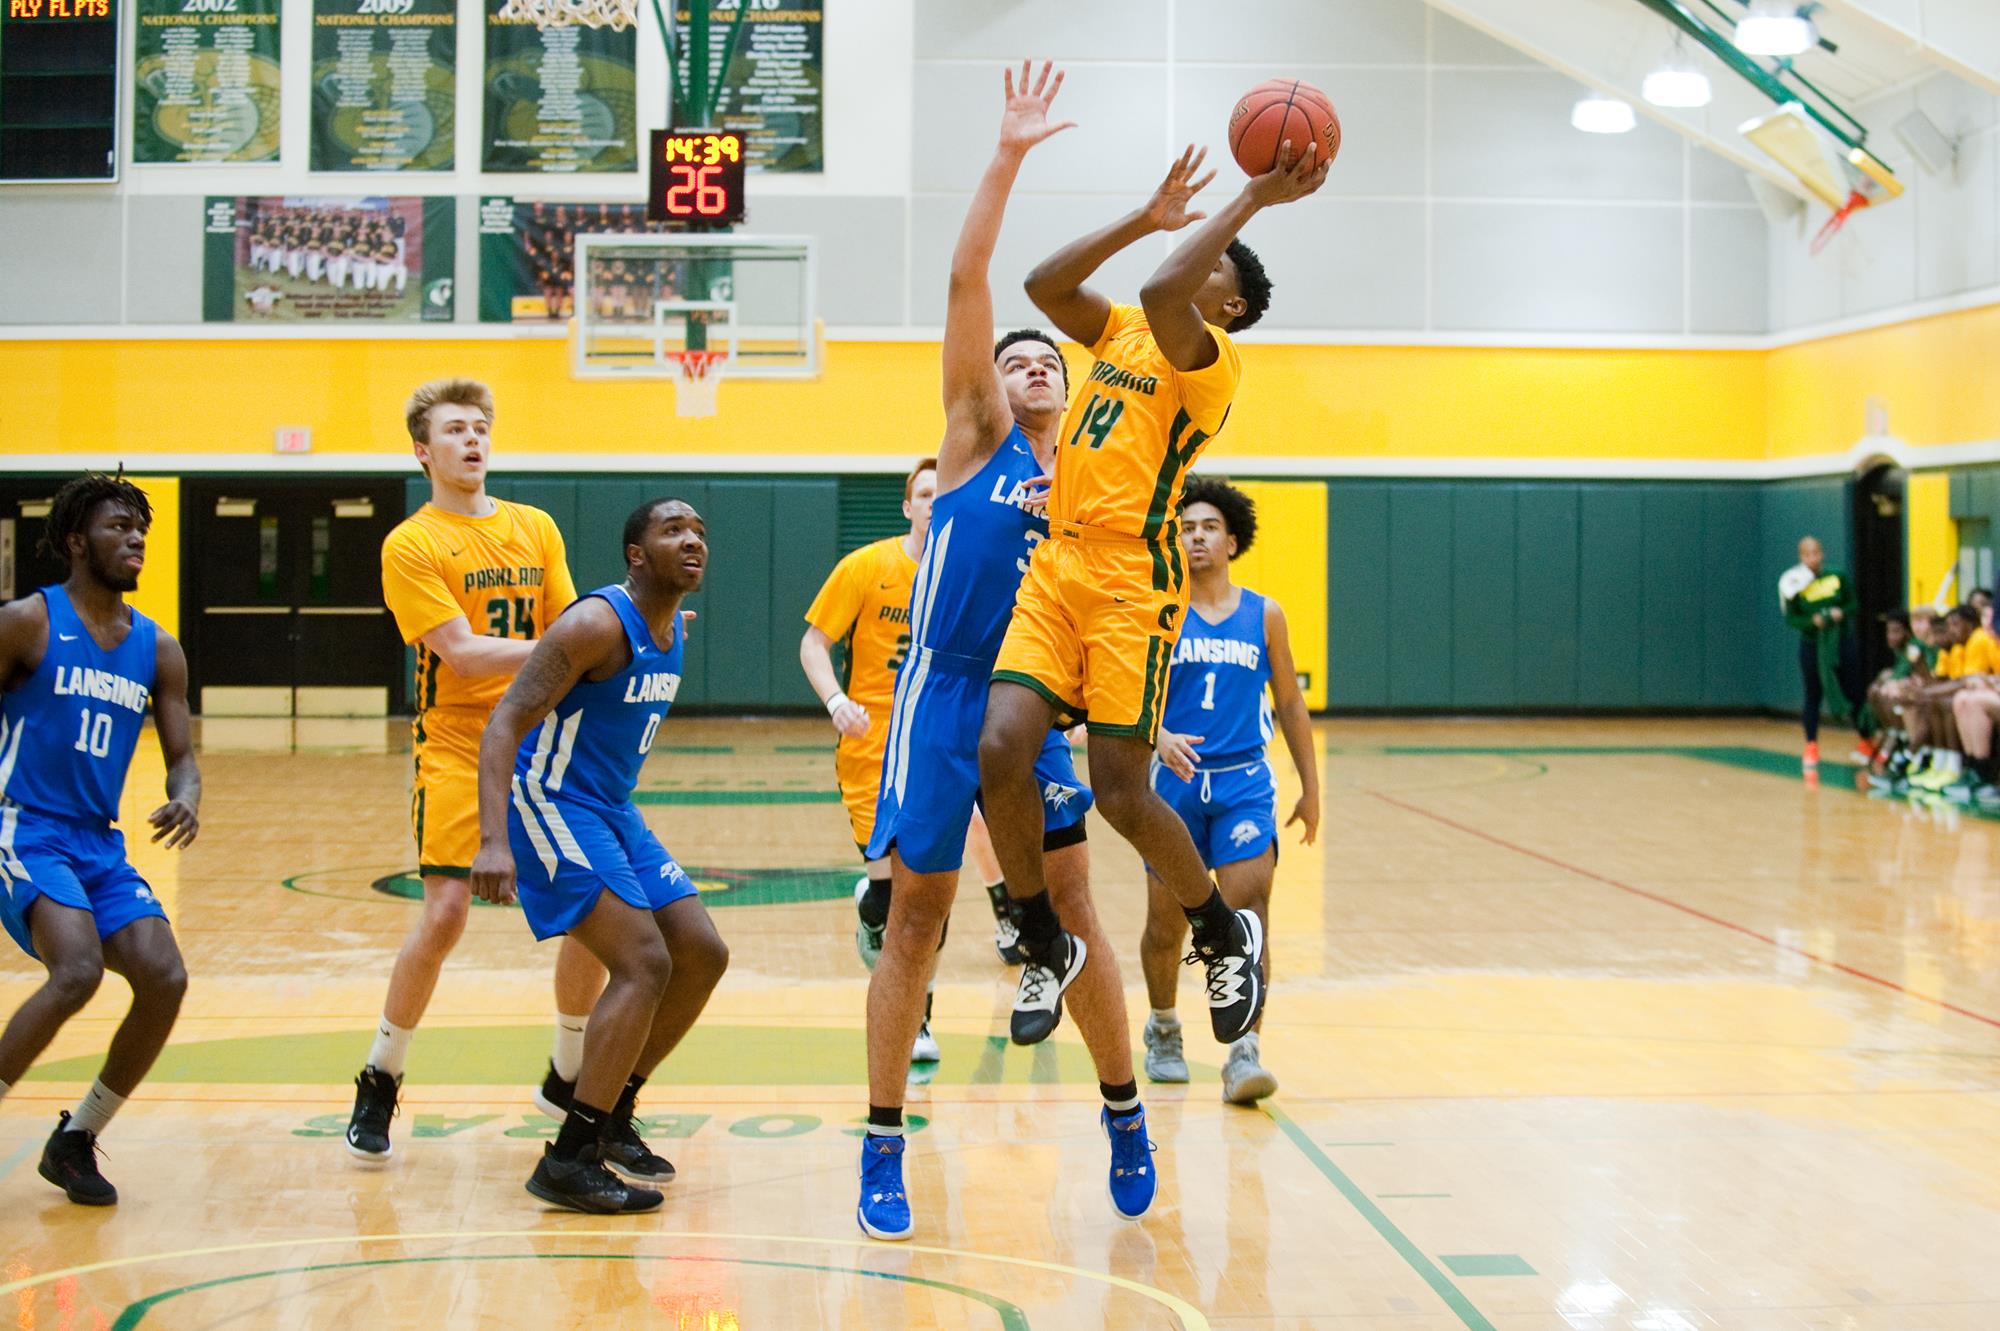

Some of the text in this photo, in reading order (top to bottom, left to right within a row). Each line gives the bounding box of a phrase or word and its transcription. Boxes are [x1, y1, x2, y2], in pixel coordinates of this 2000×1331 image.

[10, 0, 109, 18] PLY FL PTS
[142, 14, 277, 26] NATIONAL CHAMPIONS
[316, 14, 454, 26] NATIONAL CHAMPIONS
[666, 135, 739, 165] 14:39
[667, 165, 726, 214] 26
[1070, 393, 1124, 450] 14
[464, 572, 545, 594] PARKLAND
[486, 597, 535, 641] 34
[1170, 637, 1260, 671] LANSING
[54, 666, 149, 714] LANSING
[1201, 672, 1216, 711] 1
[74, 708, 113, 758] 10
[638, 713, 661, 755] 0
